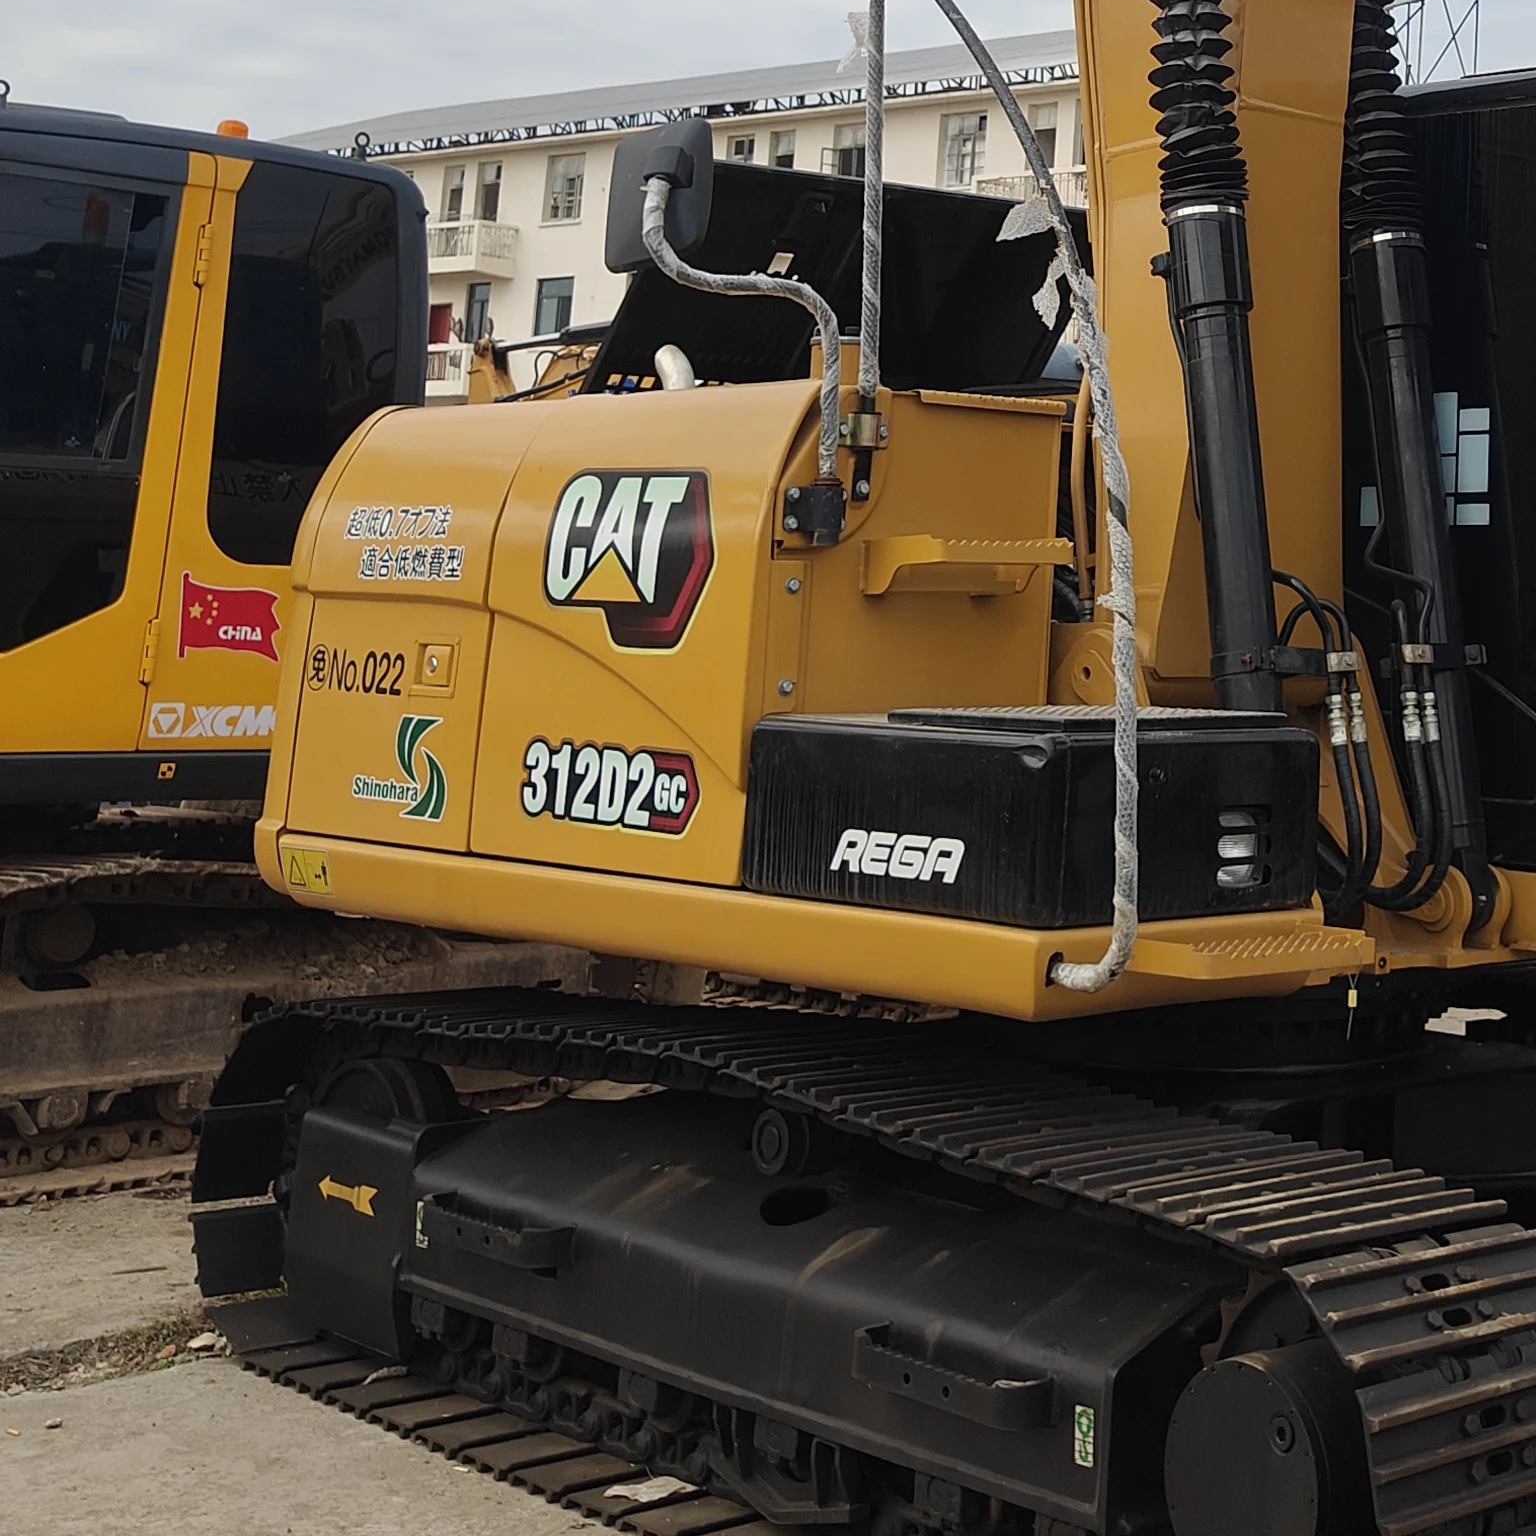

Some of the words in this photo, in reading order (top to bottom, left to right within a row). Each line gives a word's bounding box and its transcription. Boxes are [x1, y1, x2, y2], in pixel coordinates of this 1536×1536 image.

[549, 474, 691, 603] CAT
[359, 545, 465, 579] 適合低燃費型
[182, 705, 276, 738] XCM
[353, 776, 419, 802] Shinohara
[524, 741, 655, 827] 312D2
[654, 770, 687, 815] GC
[829, 828, 966, 886] REGA
